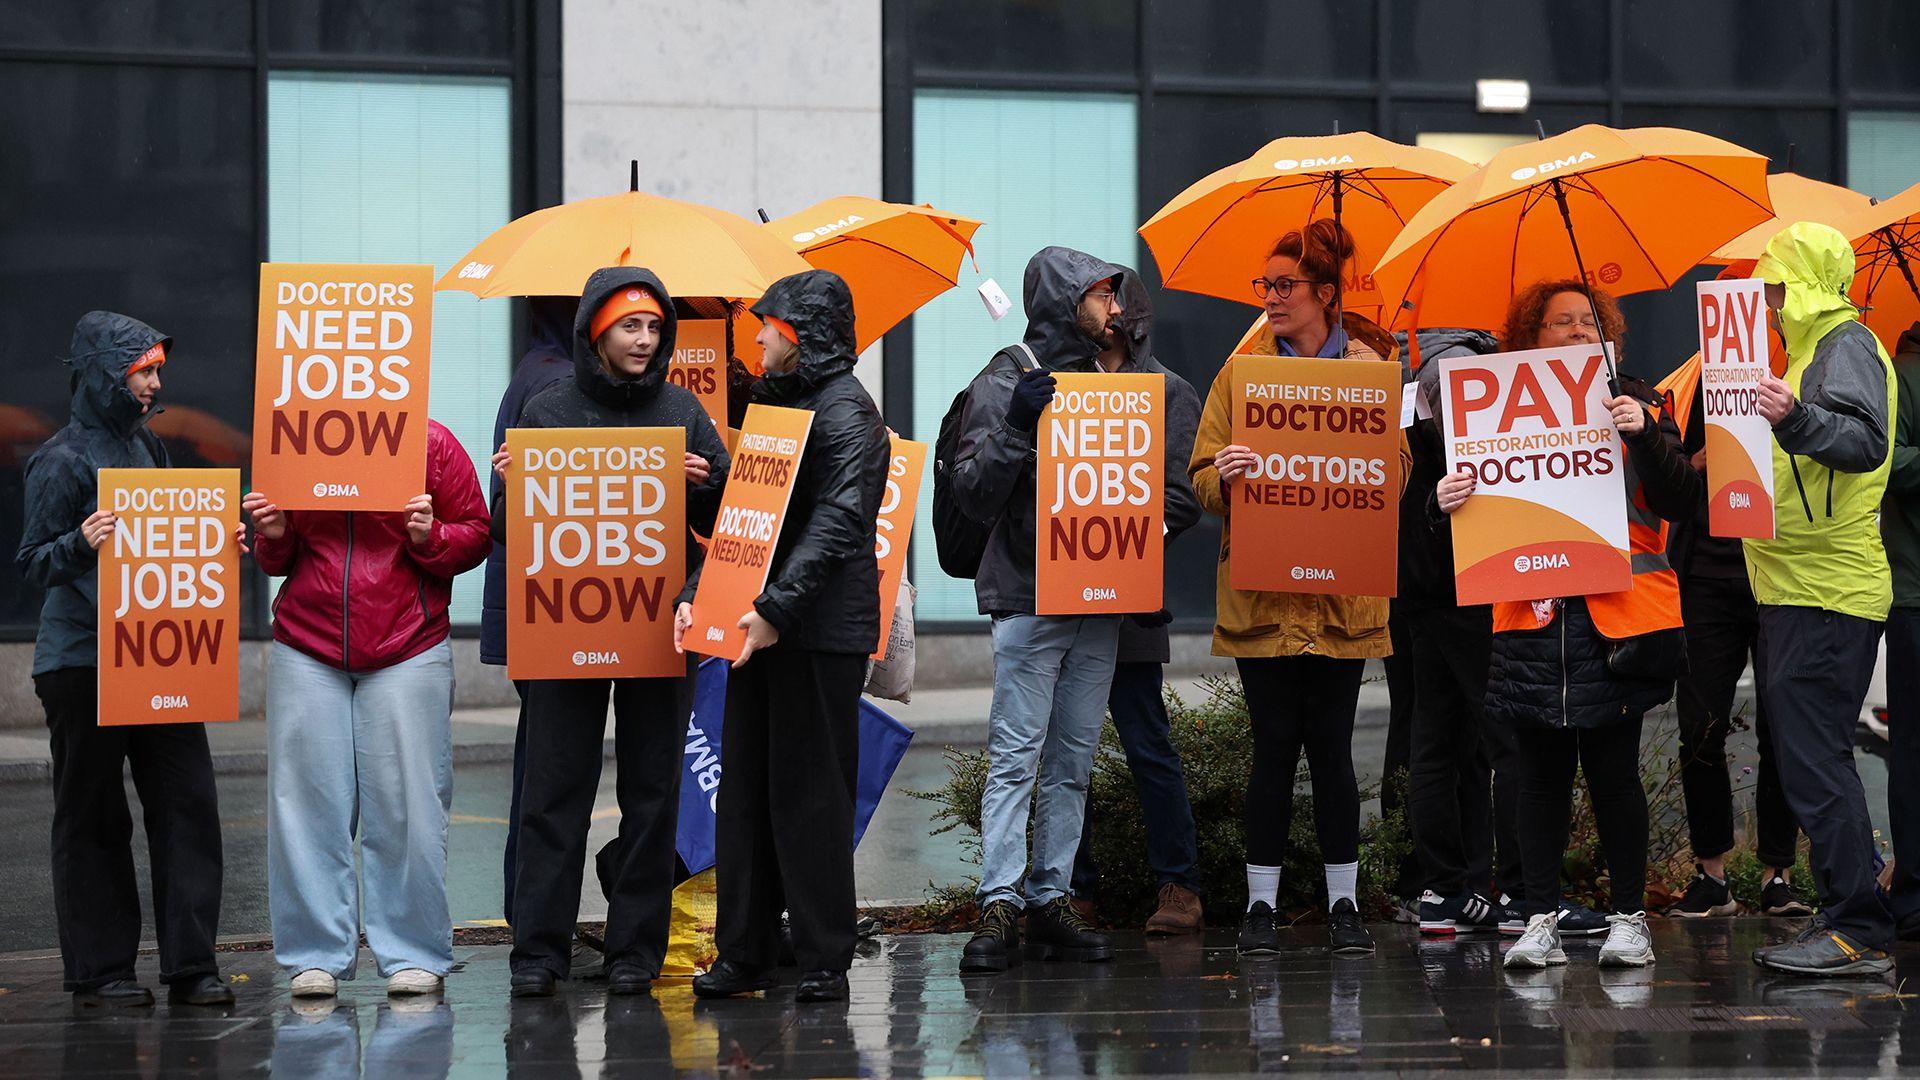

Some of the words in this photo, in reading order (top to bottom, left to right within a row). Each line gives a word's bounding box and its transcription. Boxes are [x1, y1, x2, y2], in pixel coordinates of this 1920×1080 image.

[1300, 153, 1355, 168] BMA
[1537, 150, 1596, 174] BMA
[811, 213, 865, 238] BMA
[465, 262, 495, 280] BMA
[277, 281, 414, 307] DOCTORS
[275, 309, 413, 351] NEED
[1701, 291, 1759, 364] PAY
[676, 348, 716, 364] NEED
[273, 355, 410, 407] JOBS
[1705, 368, 1750, 383] RESTORATION
[1051, 391, 1152, 415] DOCTORS
[1245, 383, 1332, 402] PATIENTS
[1337, 387, 1387, 404] NEED
[1449, 354, 1604, 437] PAY
[1706, 389, 1760, 417] DOCTOR
[270, 409, 408, 457] NOW
[1245, 402, 1387, 435] DOCTORS
[741, 433, 776, 453] PATIENTS
[776, 438, 798, 455] NEED
[1050, 418, 1151, 458] NEED
[1454, 432, 1575, 457] RESTORATION
[1579, 428, 1611, 445] FOR
[524, 446, 666, 472] DOCTORS
[733, 453, 791, 488] DOCTORS
[1244, 453, 1386, 485] DOCTORS
[1456, 447, 1614, 485] DOCTORS
[113, 487, 226, 512] DOCTORS
[328, 484, 359, 497] BMA
[524, 475, 665, 517] NEED
[1050, 462, 1151, 514] JOBS
[1244, 483, 1316, 507] NEED
[1321, 486, 1385, 512] JOBS
[1736, 492, 1751, 510] BMA
[113, 516, 226, 559] NEED
[718, 505, 776, 542] DOCTORS
[525, 520, 666, 577] JOBS
[711, 537, 741, 563] NEED
[738, 543, 767, 569] JOBS
[1050, 516, 1150, 561] NOW
[1305, 567, 1335, 581] BMA
[1532, 553, 1570, 570] BMA
[114, 562, 226, 619] JOBS
[524, 576, 665, 624] NOW
[1094, 588, 1117, 600] BMA
[113, 618, 224, 668] NOW
[713, 627, 725, 643] BMA
[588, 651, 620, 664] BMA
[163, 694, 188, 709] BMA
